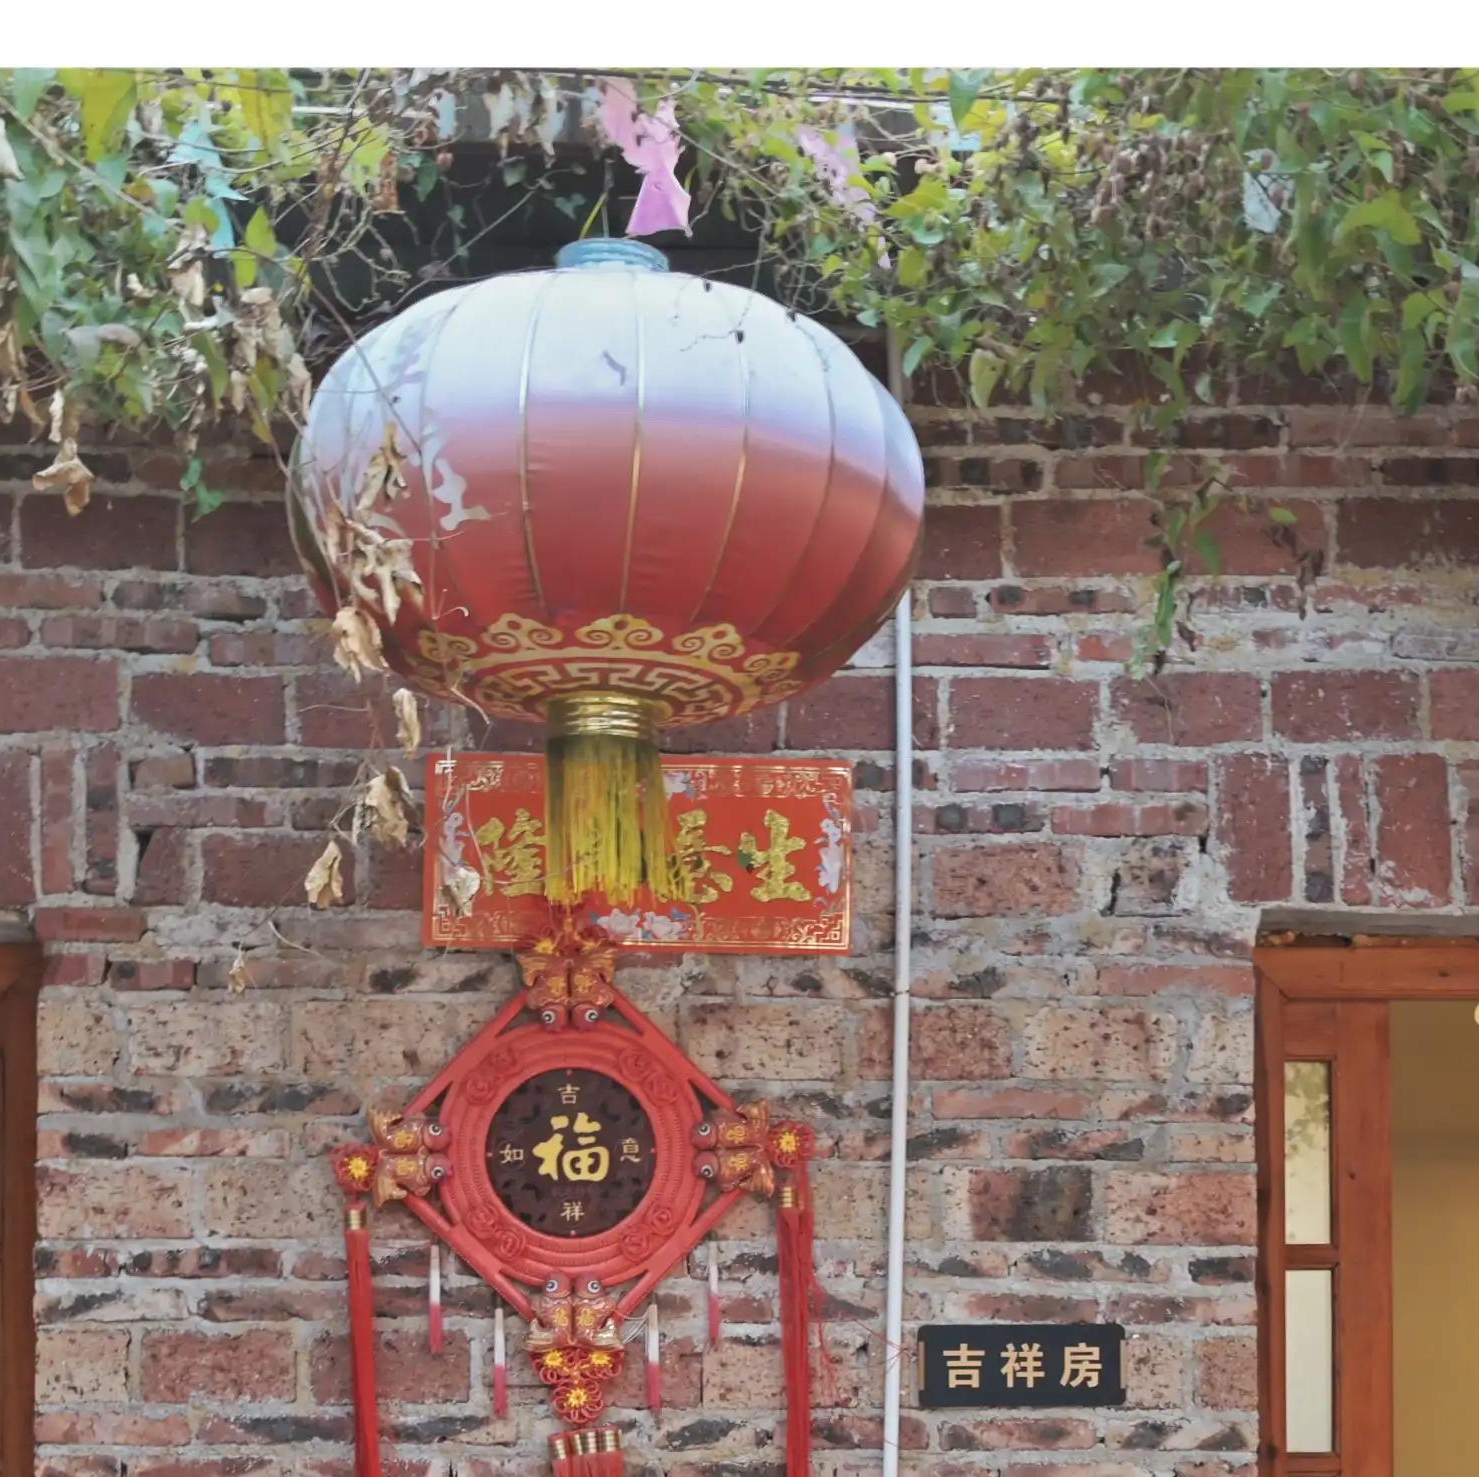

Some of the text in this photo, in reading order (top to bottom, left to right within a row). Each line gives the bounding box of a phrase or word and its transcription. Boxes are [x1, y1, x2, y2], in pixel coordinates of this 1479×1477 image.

[557, 1083, 581, 1105] 吉
[499, 1144, 524, 1164] 如
[532, 1111, 610, 1182] 福
[619, 1137, 642, 1163] 意
[560, 1201, 585, 1222] 祥
[942, 1342, 1103, 1389] 吉祥房
